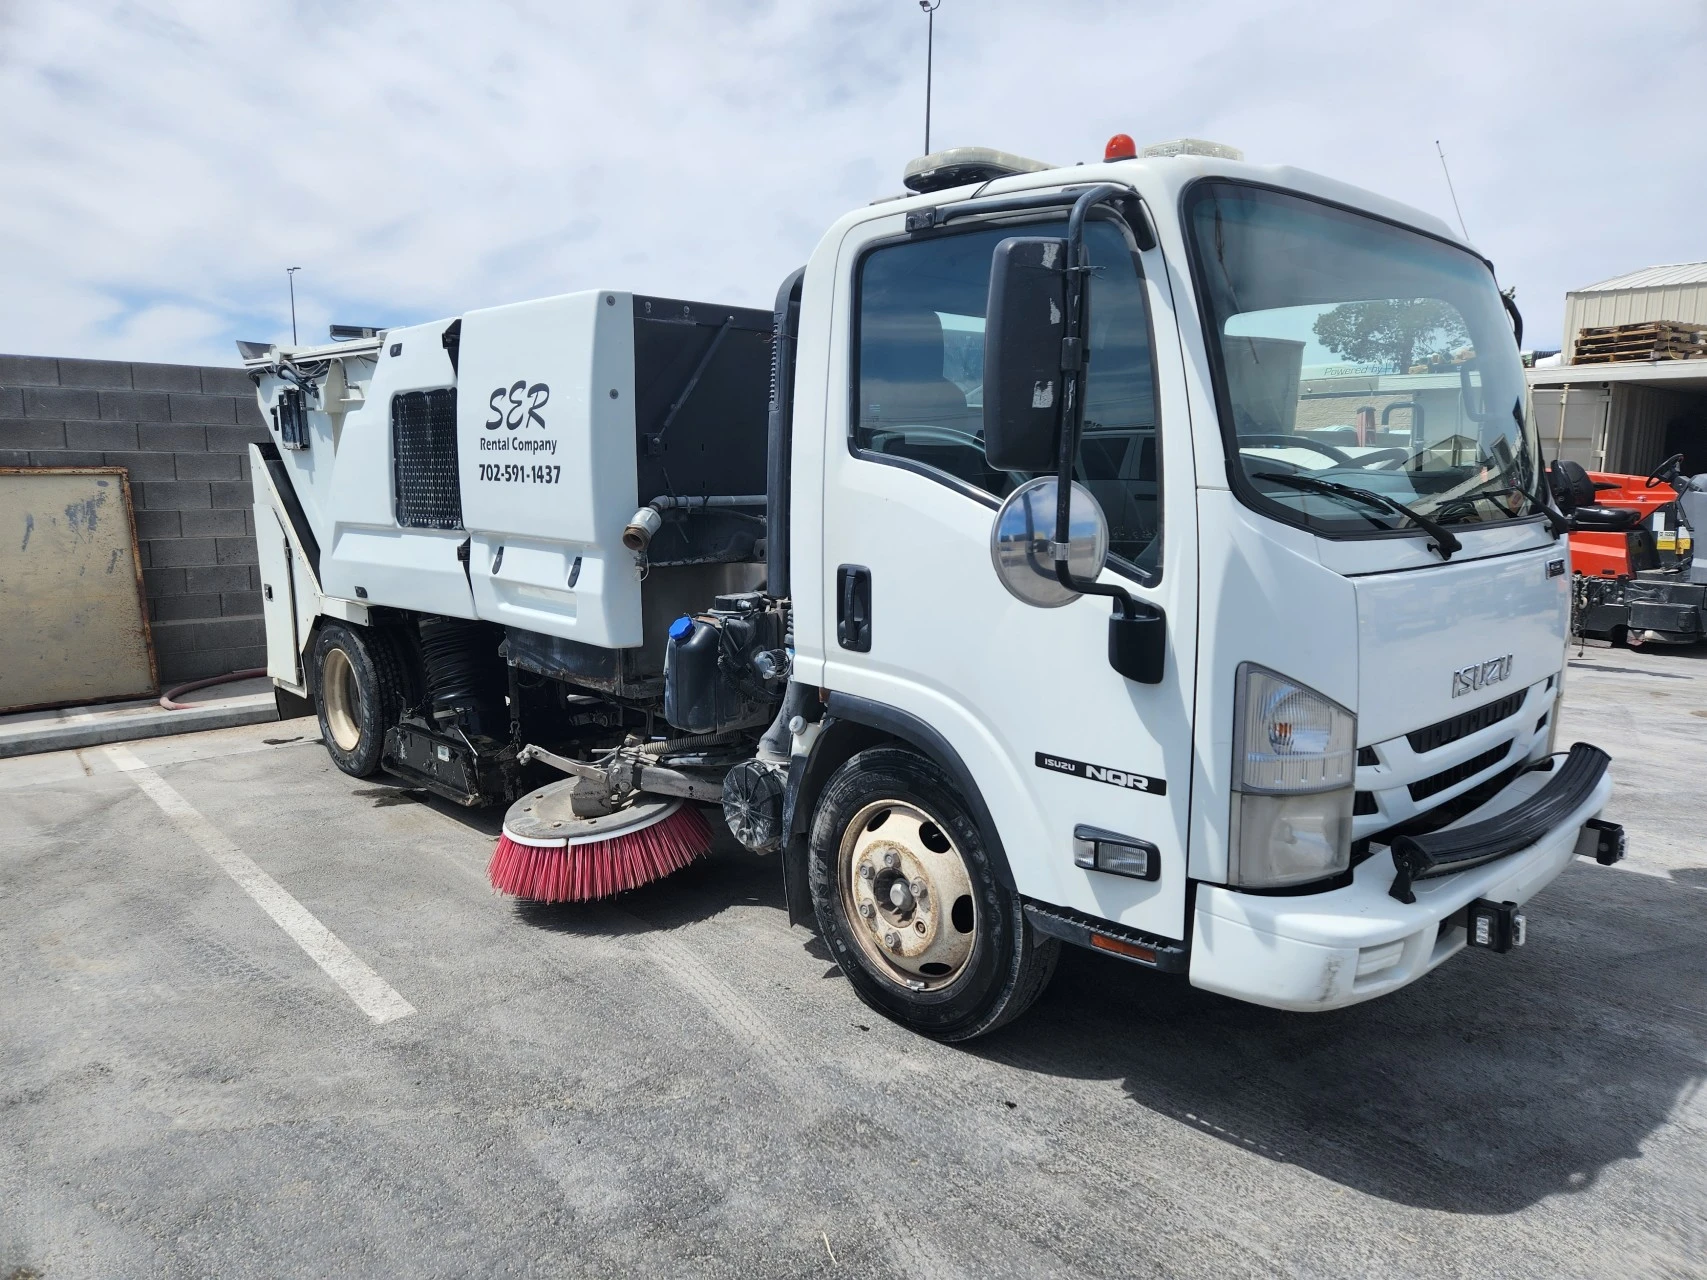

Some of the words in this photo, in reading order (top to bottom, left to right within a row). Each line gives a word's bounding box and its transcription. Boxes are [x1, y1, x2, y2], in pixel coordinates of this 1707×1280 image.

[1324, 365, 1368, 376] Powered
[1371, 364, 1382, 376] by
[486, 380, 550, 430] SER
[480, 437, 510, 451] Rental
[512, 437, 557, 455] Company
[479, 464, 561, 484] 702-591-1437
[1452, 652, 1513, 698] ISUZU
[1044, 757, 1076, 771] ISUZU
[1085, 765, 1149, 791] NQR
